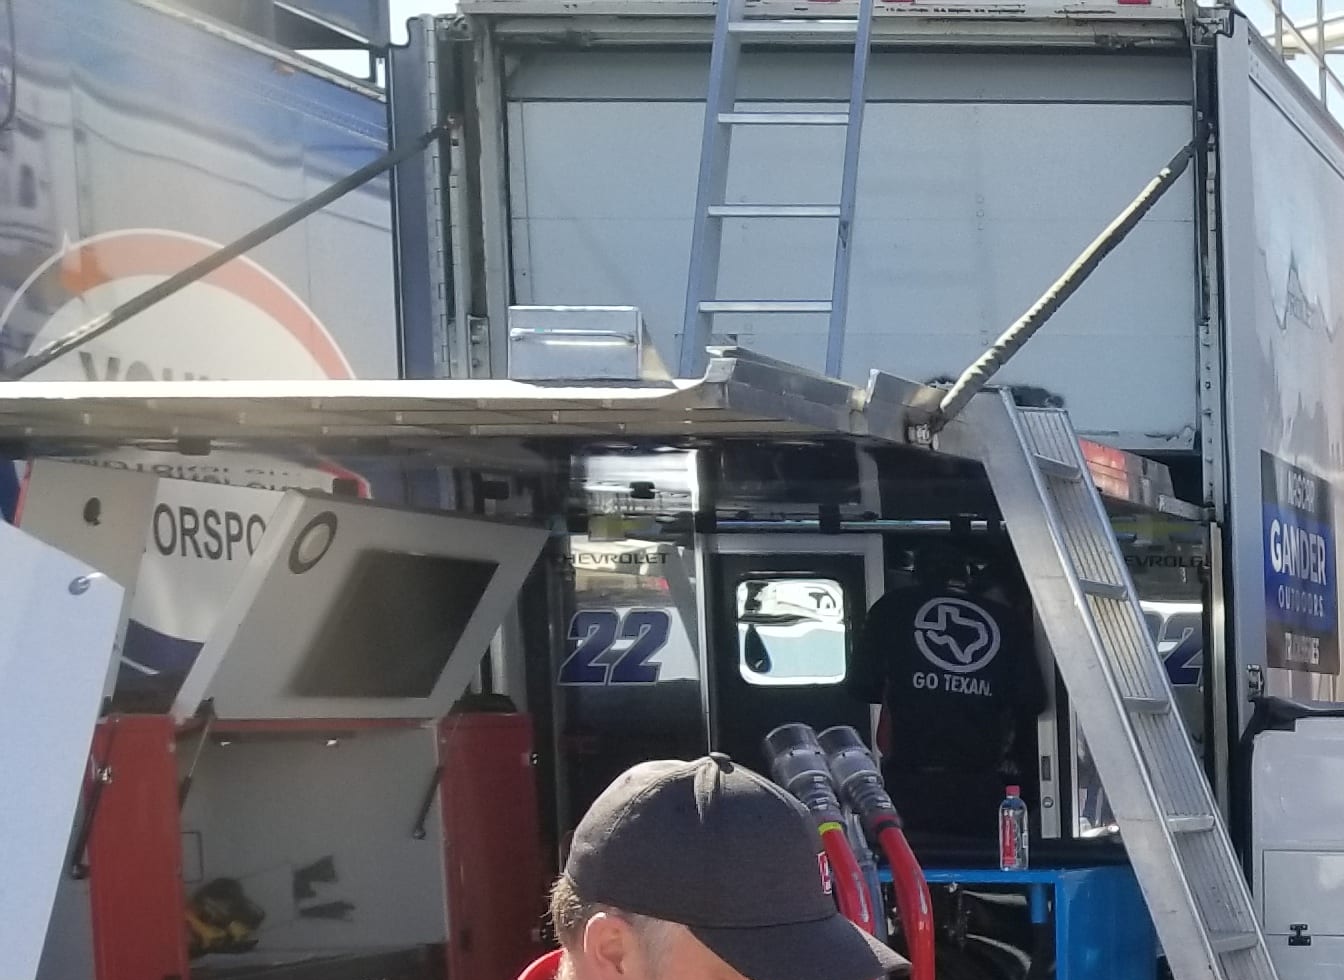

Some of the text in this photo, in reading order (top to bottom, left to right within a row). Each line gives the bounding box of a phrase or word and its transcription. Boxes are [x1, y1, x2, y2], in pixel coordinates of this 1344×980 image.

[1269, 518, 1327, 586] GANDER
[1278, 584, 1325, 618] OUTDOORS
[557, 606, 673, 687] 22
[912, 671, 939, 690] GO
